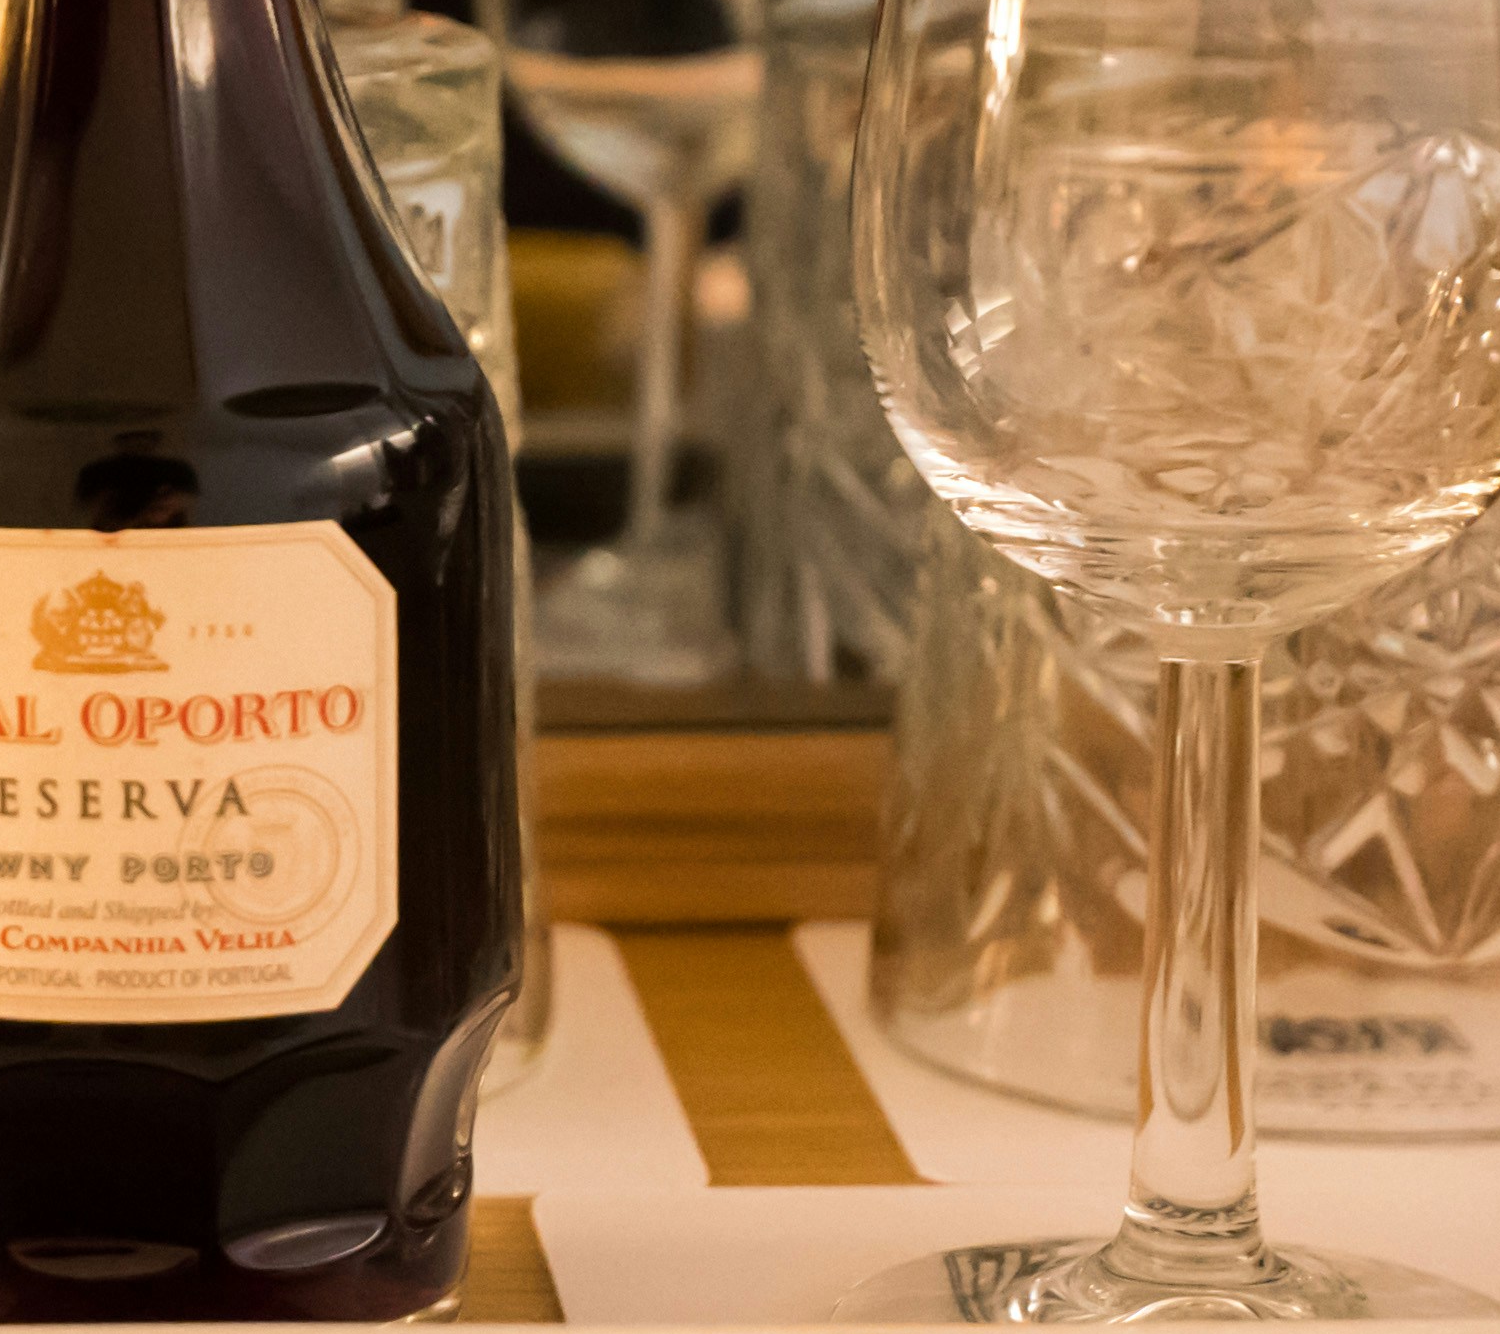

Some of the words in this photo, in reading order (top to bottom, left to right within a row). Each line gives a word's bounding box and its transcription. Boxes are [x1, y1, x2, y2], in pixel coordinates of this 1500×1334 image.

[79, 682, 365, 747] OPORTO
[119, 849, 275, 884] PORTO
[58, 898, 98, 920] and
[0, 924, 187, 955] COMPANHIA
[194, 927, 299, 954] VELHA
